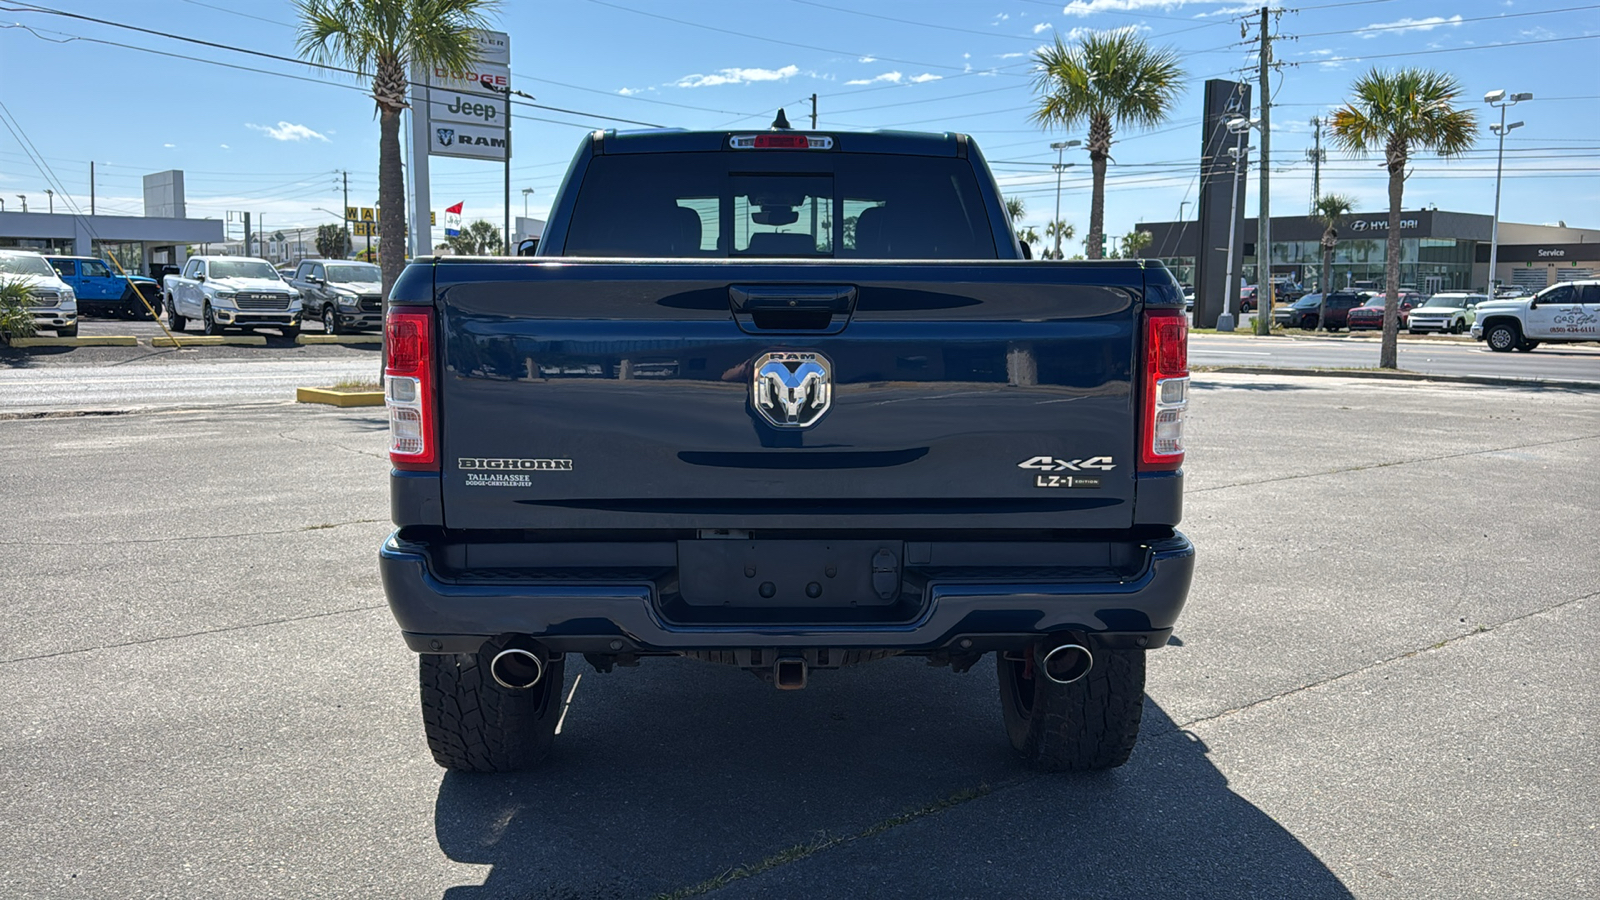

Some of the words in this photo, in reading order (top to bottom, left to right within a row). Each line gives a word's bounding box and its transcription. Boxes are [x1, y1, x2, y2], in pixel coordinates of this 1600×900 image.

[434, 67, 507, 86] DODGE
[447, 96, 496, 121] Jeep
[458, 134, 506, 148] RAM
[1370, 219, 1418, 230] HYUDAI
[1538, 249, 1565, 257] Service
[458, 458, 573, 471] BIGHORN
[1017, 456, 1117, 471] 4x4
[467, 473, 530, 482] TALLAHASSEE
[1037, 475, 1073, 487] LZ-1
